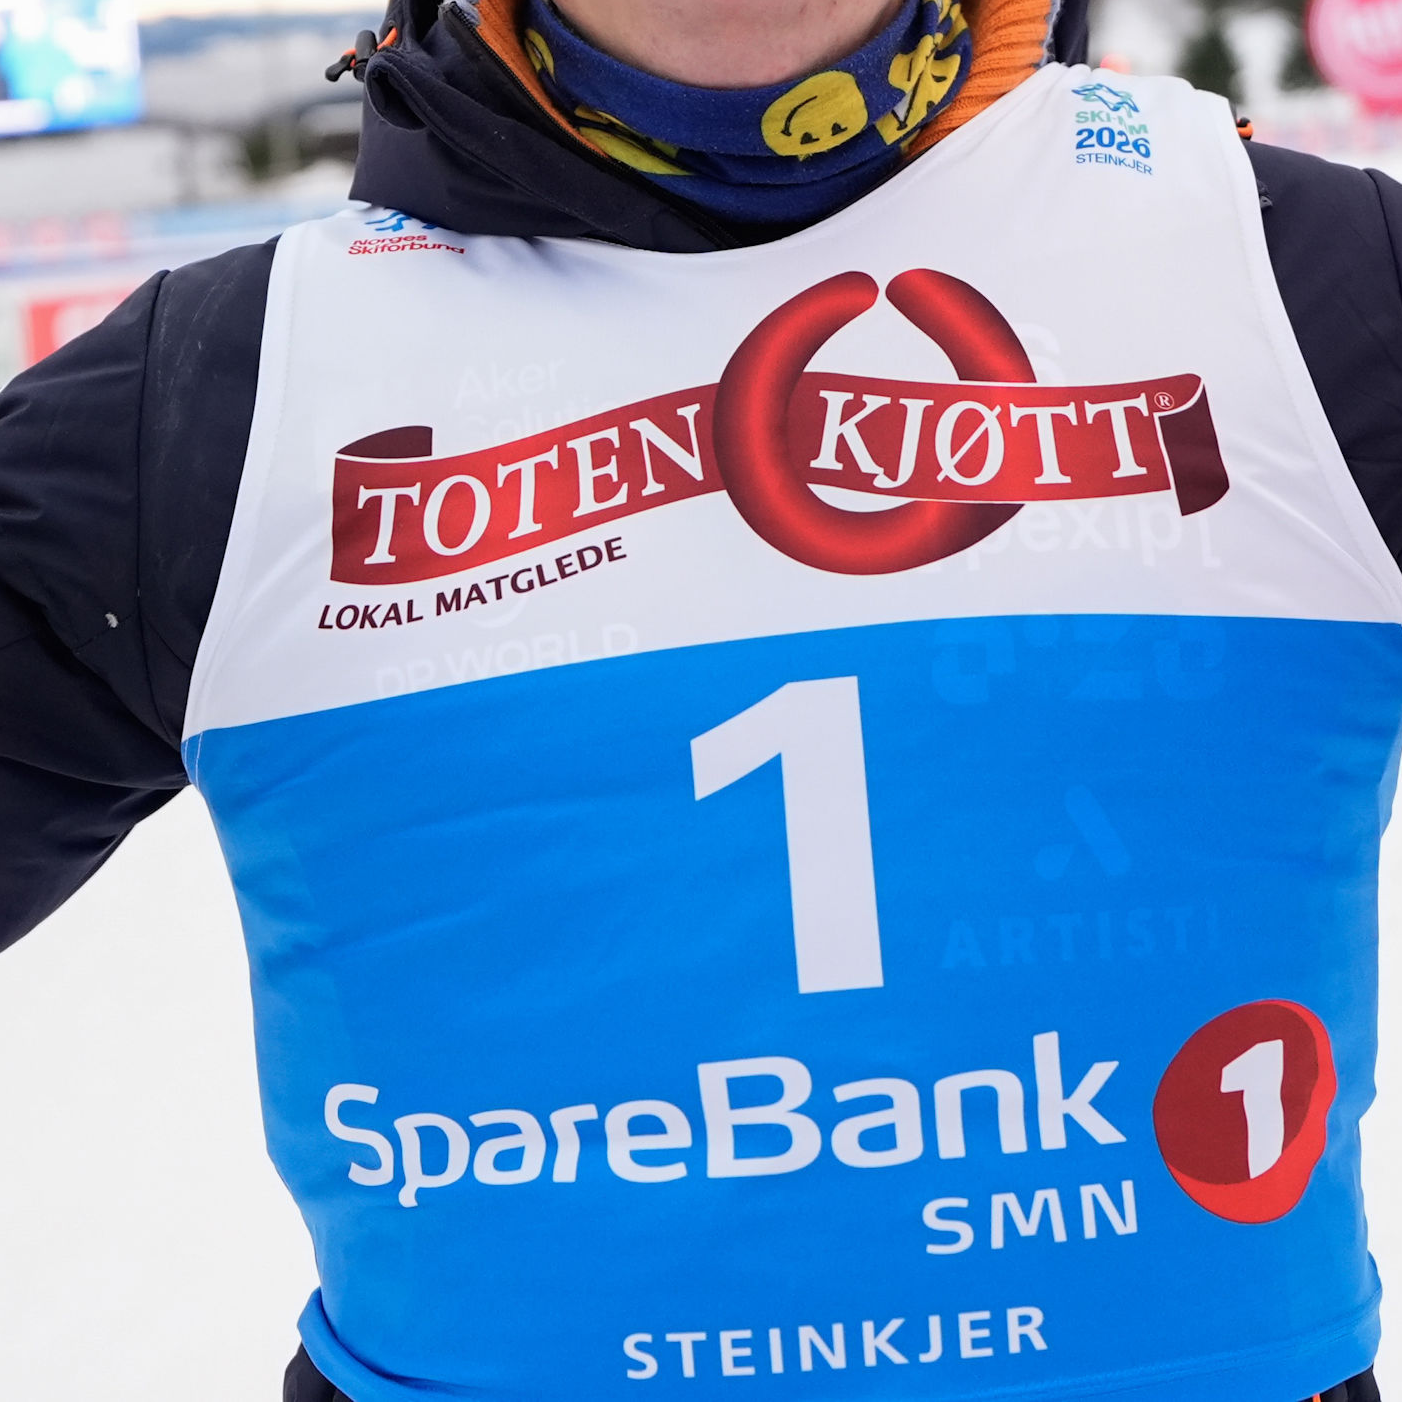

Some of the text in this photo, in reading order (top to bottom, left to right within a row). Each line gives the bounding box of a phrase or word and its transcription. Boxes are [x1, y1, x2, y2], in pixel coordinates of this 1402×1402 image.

[1075, 126, 1151, 159] 2026
[1075, 152, 1153, 175] STEINKJER
[348, 241, 465, 254] Skiforbund
[353, 235, 427, 246] Norges
[357, 402, 705, 565] TOTEN
[317, 536, 628, 630] LOKAL MATGLEDE
[689, 676, 885, 994] 1
[324, 1030, 1285, 1207] SpareBank 1
[922, 1178, 1140, 1255] SMN
[624, 1304, 1048, 1380] STEINKJER
